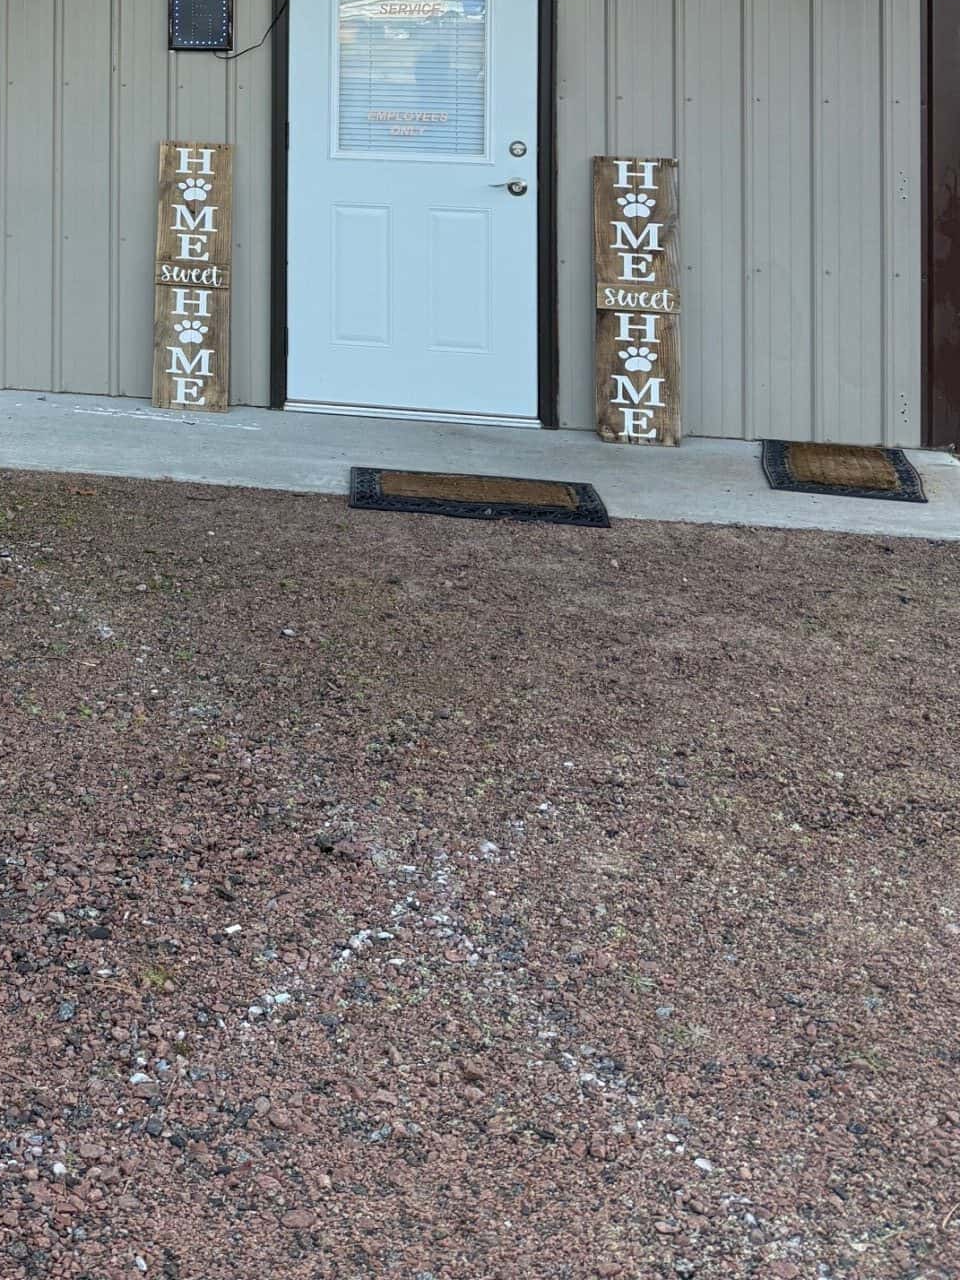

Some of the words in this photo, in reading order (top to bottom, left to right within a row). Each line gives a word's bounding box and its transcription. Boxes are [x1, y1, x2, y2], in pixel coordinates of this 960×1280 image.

[379, 3, 442, 16] SERVICE
[368, 111, 448, 122] EMPLOYEES
[160, 264, 223, 287] sweet
[604, 287, 674, 312] sweet
